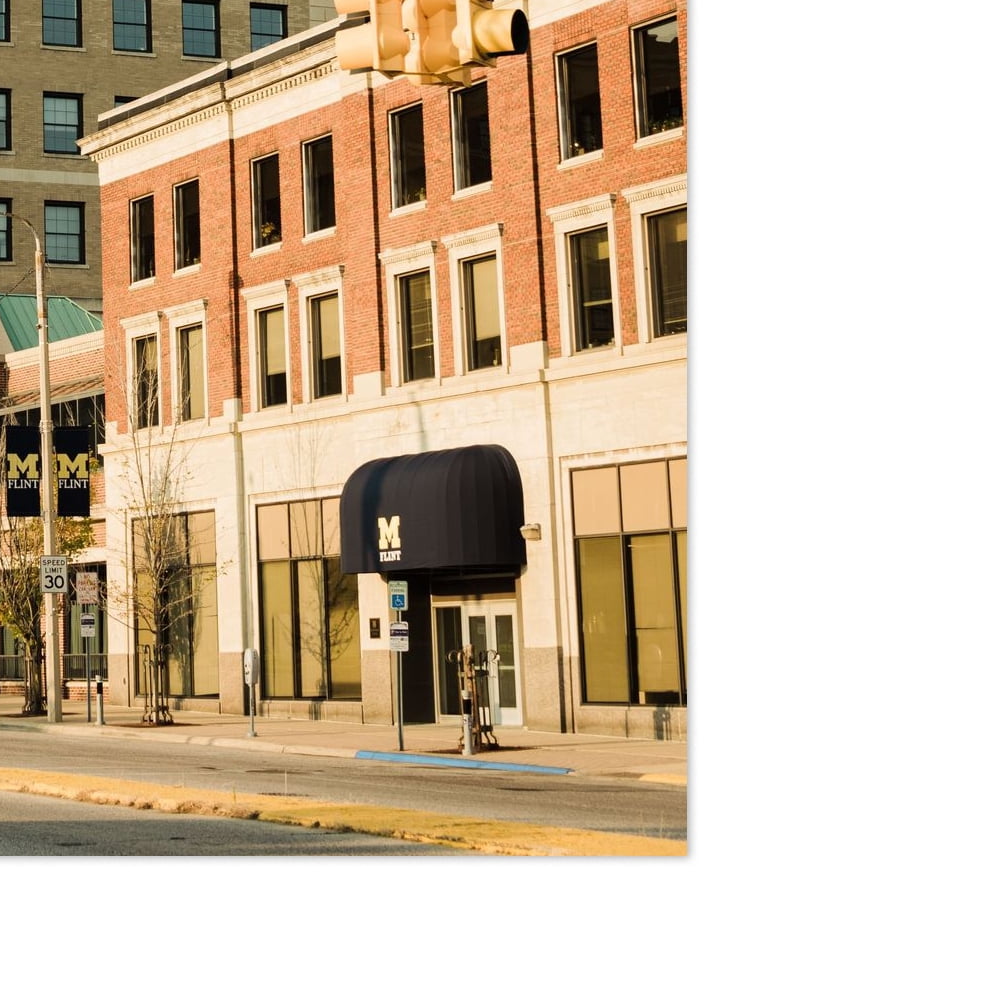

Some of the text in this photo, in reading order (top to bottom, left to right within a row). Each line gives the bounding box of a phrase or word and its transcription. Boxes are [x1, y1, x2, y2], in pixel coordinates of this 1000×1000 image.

[7, 453, 39, 478] M
[57, 453, 89, 478] M
[8, 480, 39, 489] FLINT
[58, 480, 89, 489] FLINT
[378, 516, 401, 550] M
[379, 550, 402, 562] FLINT
[45, 575, 64, 589] 30
